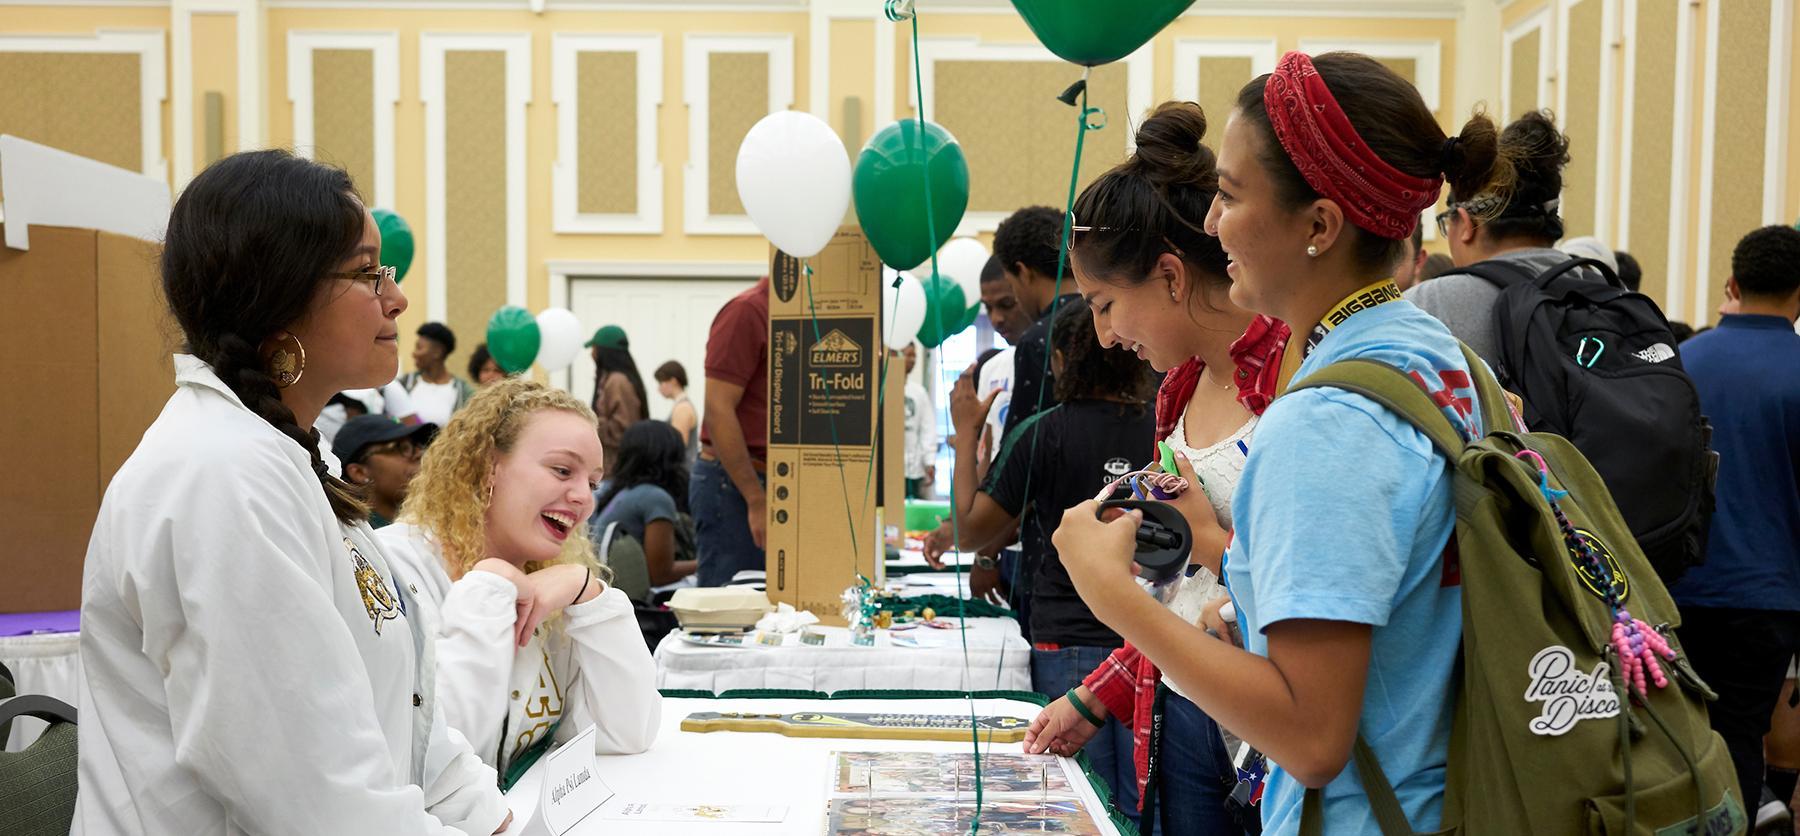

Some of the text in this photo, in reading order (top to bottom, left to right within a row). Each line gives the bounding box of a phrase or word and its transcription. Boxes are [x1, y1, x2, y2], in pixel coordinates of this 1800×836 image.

[812, 351, 859, 363] ELMER'S
[773, 331, 784, 434] Tri-Fold Display Board
[808, 372, 865, 390] Tri-Fold
[1534, 694, 1620, 731] Disco
